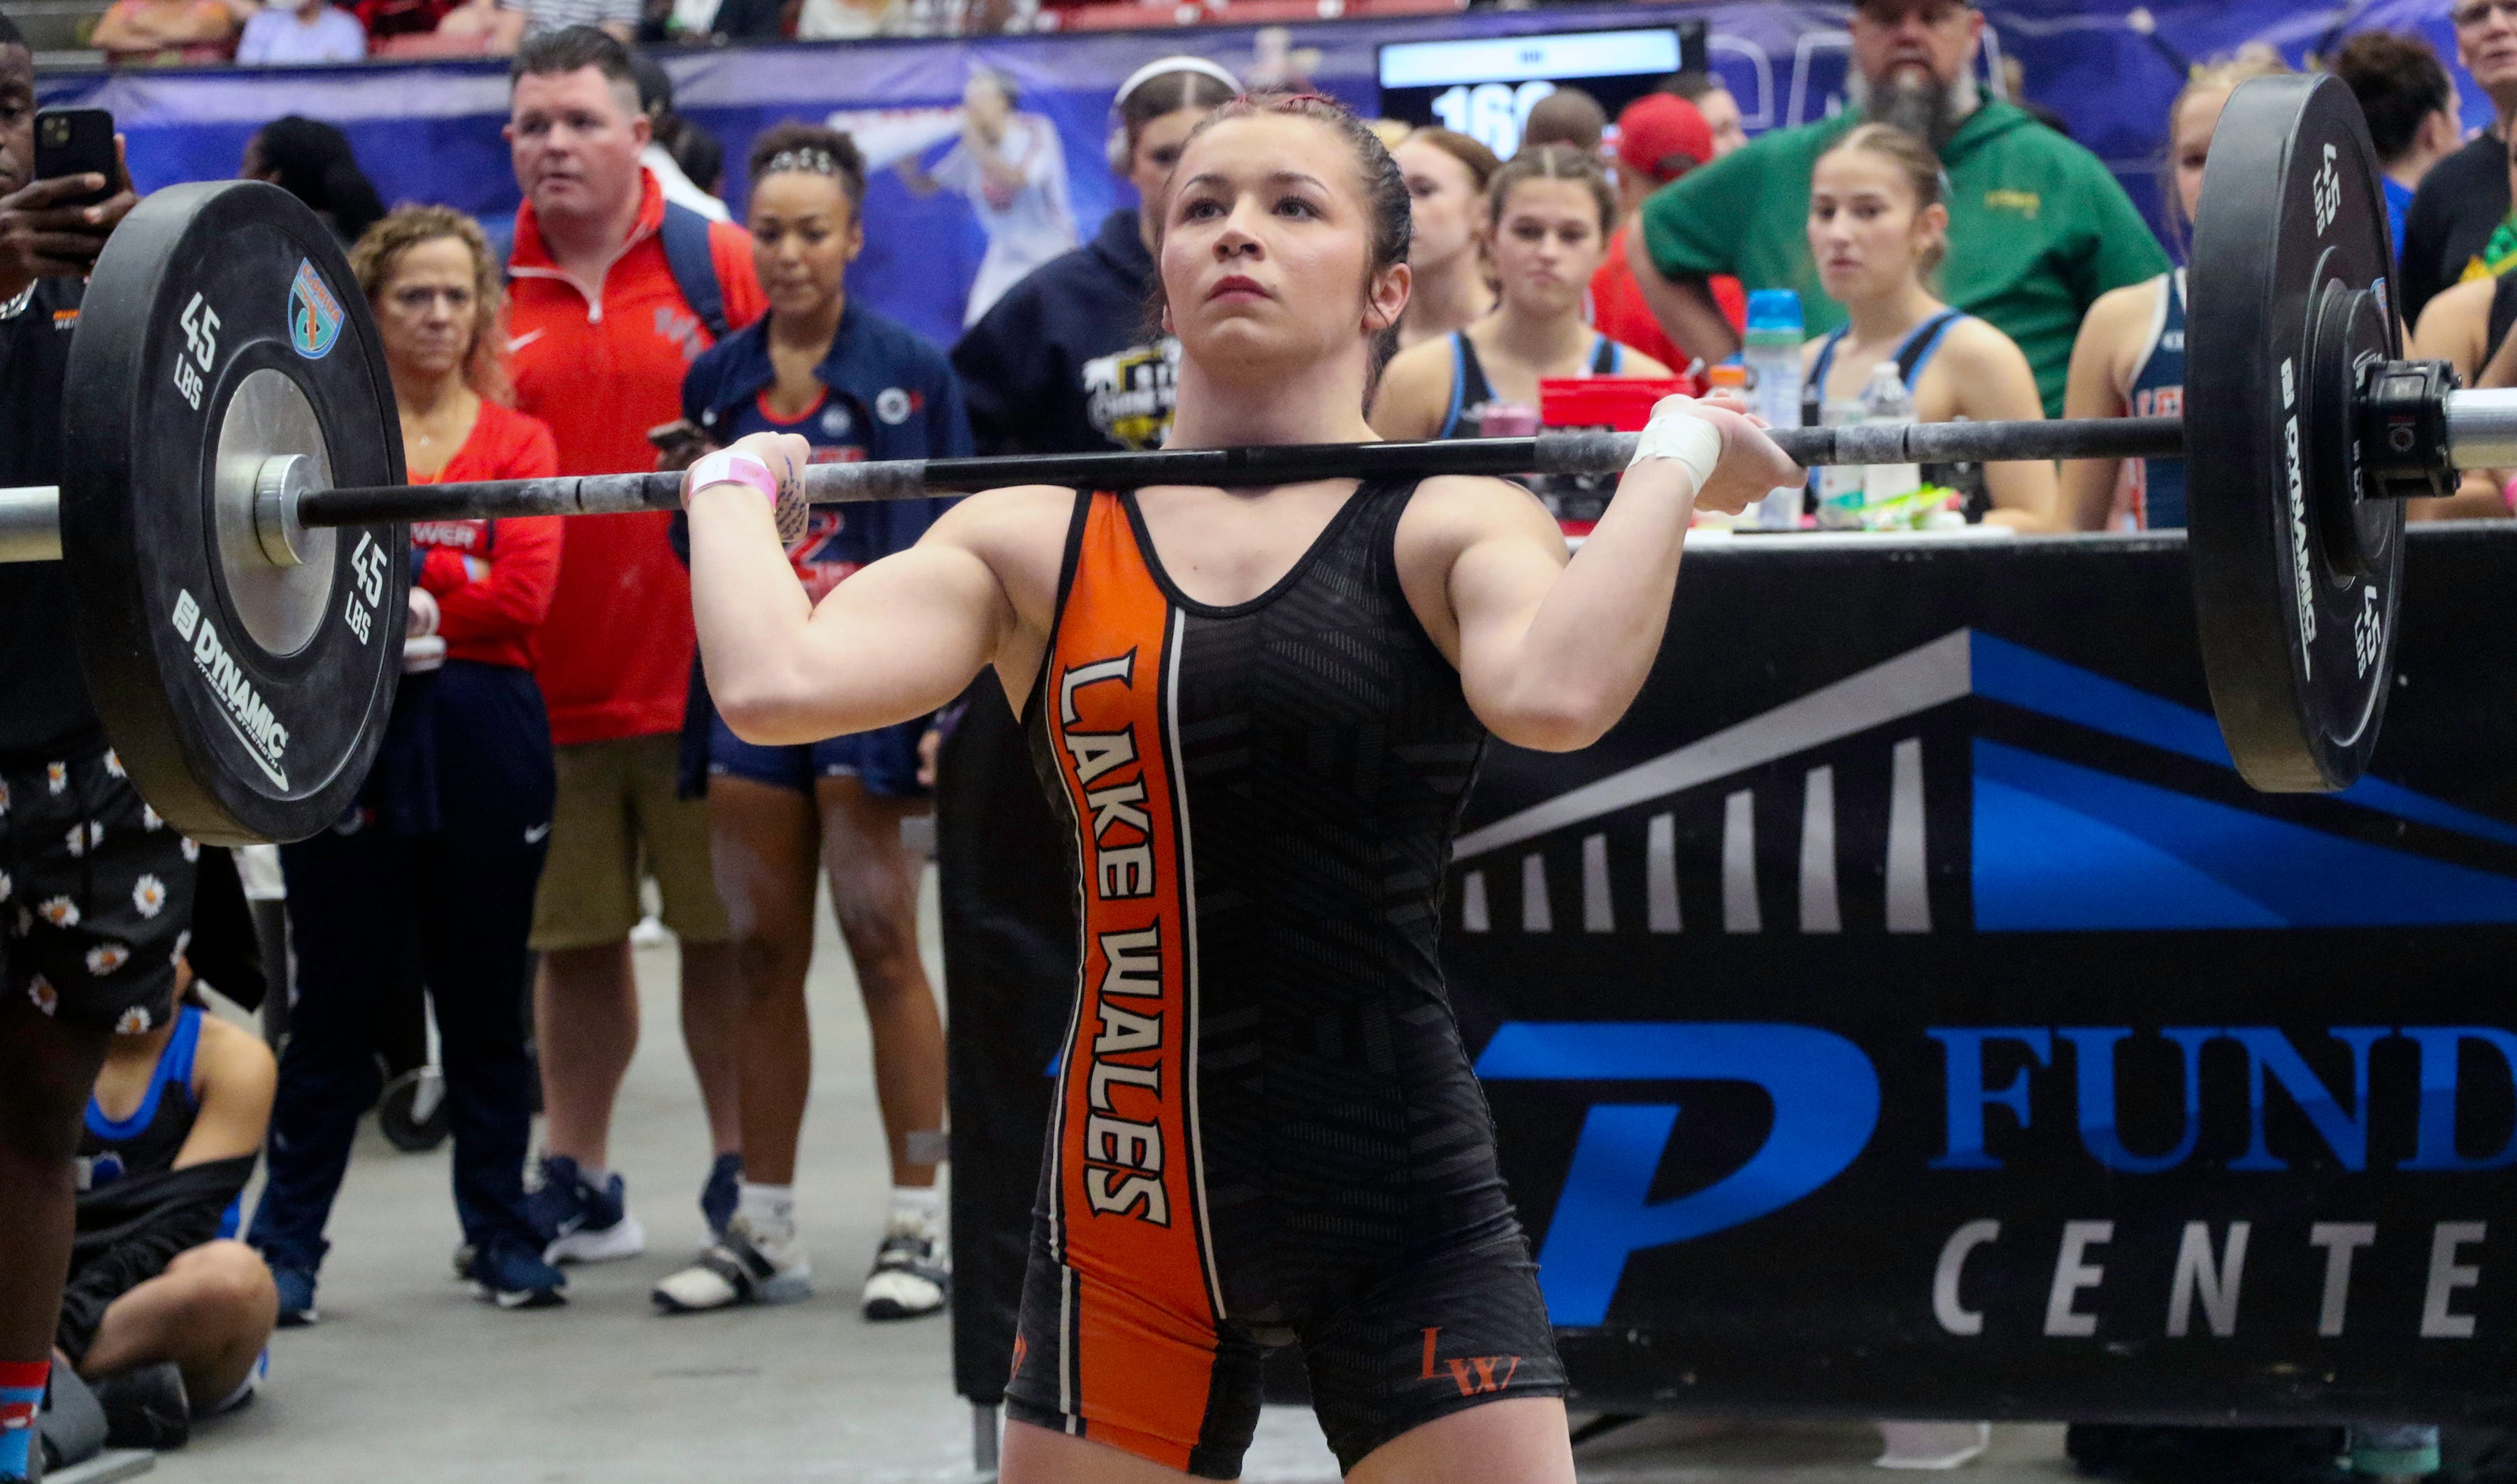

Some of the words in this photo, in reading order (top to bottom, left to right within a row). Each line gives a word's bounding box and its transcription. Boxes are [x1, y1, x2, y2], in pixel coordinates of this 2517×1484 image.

[2312, 168, 2326, 238] LBS
[2323, 142, 2342, 226] 45
[180, 290, 221, 373] 45
[301, 263, 342, 324] FLORIDA
[173, 352, 203, 411] LBS
[351, 530, 388, 609] 45
[410, 524, 478, 549] WER
[344, 590, 372, 646] LBS
[2354, 611, 2368, 680] LBS
[2364, 584, 2381, 665] 45
[193, 617, 287, 760] DYNAMIC
[193, 656, 229, 703] FITNESS
[235, 710, 279, 769] STRENGTH
[1059, 645, 1156, 901] LAKE
[1084, 914, 1171, 1222] WALES
[1926, 1025, 2517, 1174] FUND
[1932, 1218, 2488, 1339] CENTE
[1417, 1326, 1521, 1397] LW
